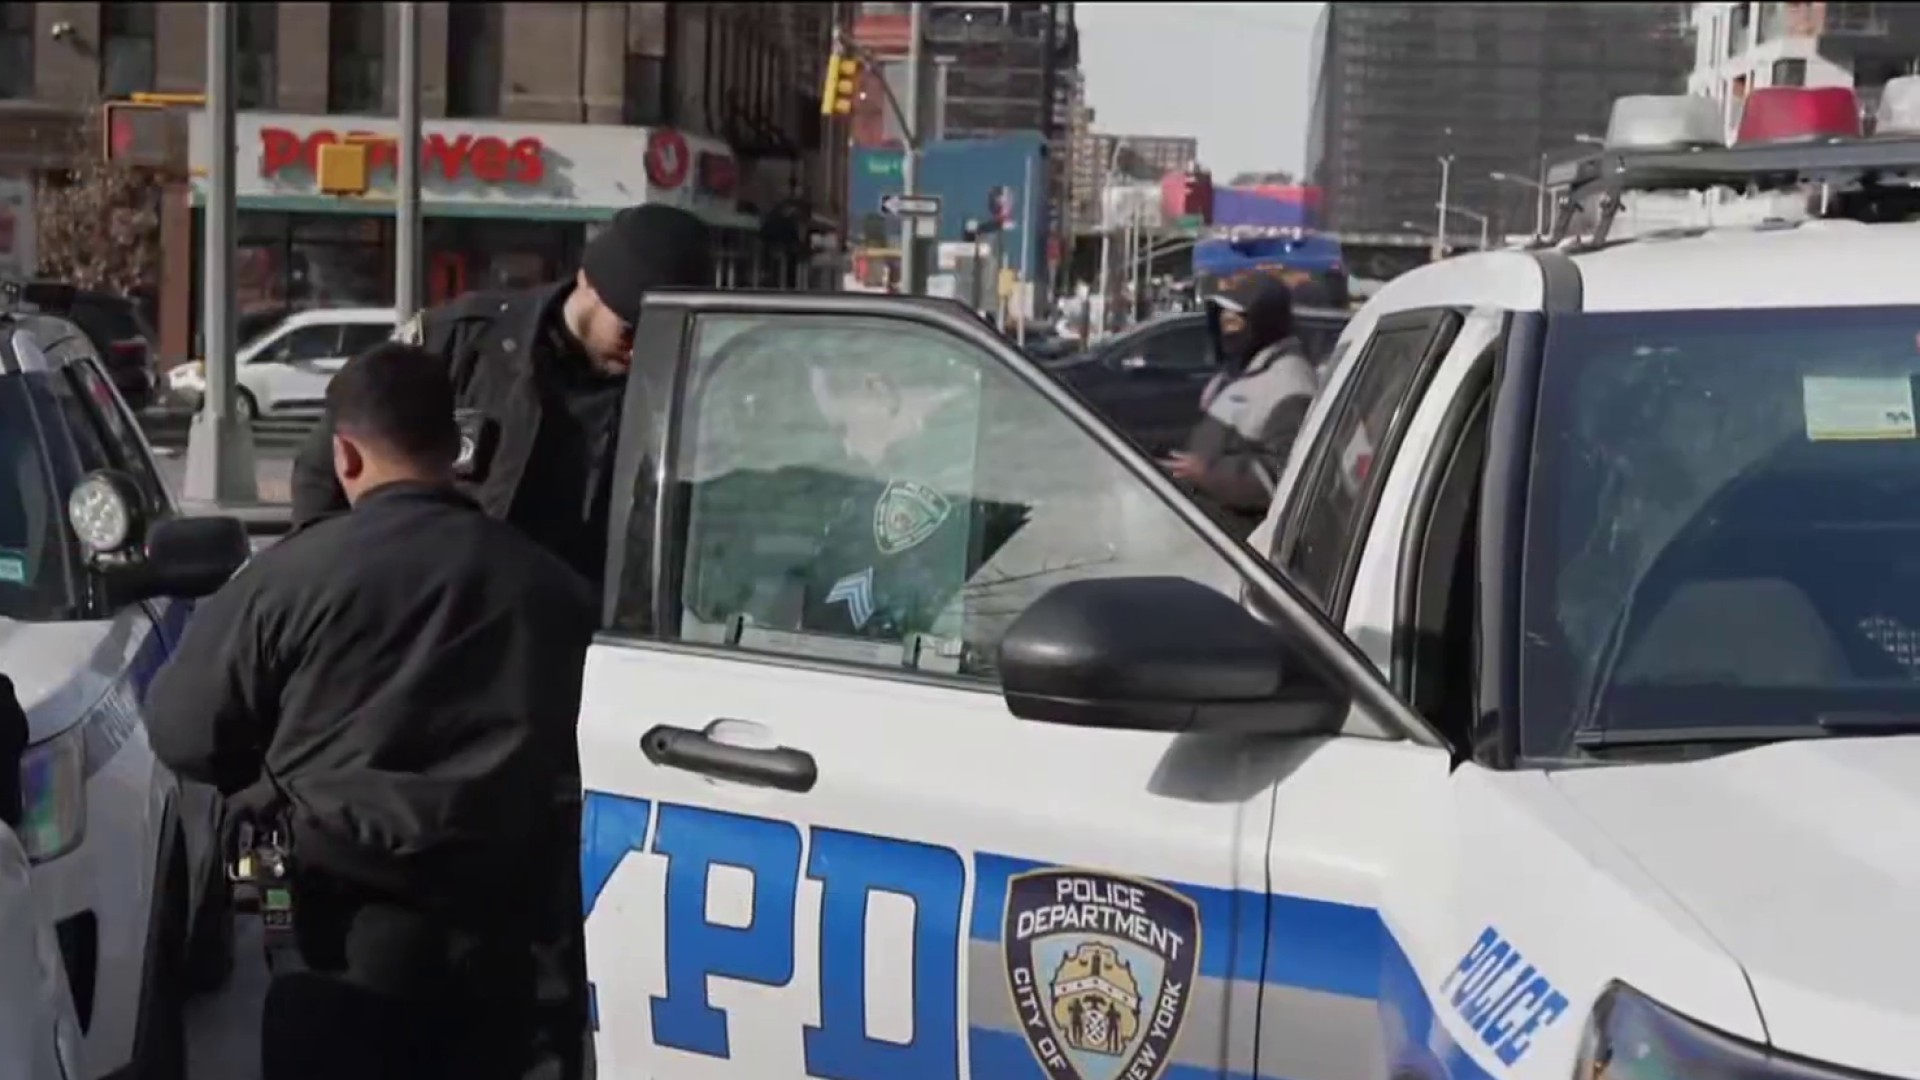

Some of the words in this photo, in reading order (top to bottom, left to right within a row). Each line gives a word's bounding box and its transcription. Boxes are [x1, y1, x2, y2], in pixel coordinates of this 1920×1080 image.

[1016, 904, 1184, 960] DEPARTMENT
[1056, 878, 1147, 914] POLICE
[1013, 967, 1046, 1029] CITY
[1038, 1036, 1067, 1070] OF
[1150, 979, 1183, 1039] YORK
[1439, 926, 1569, 1067] POLICE
